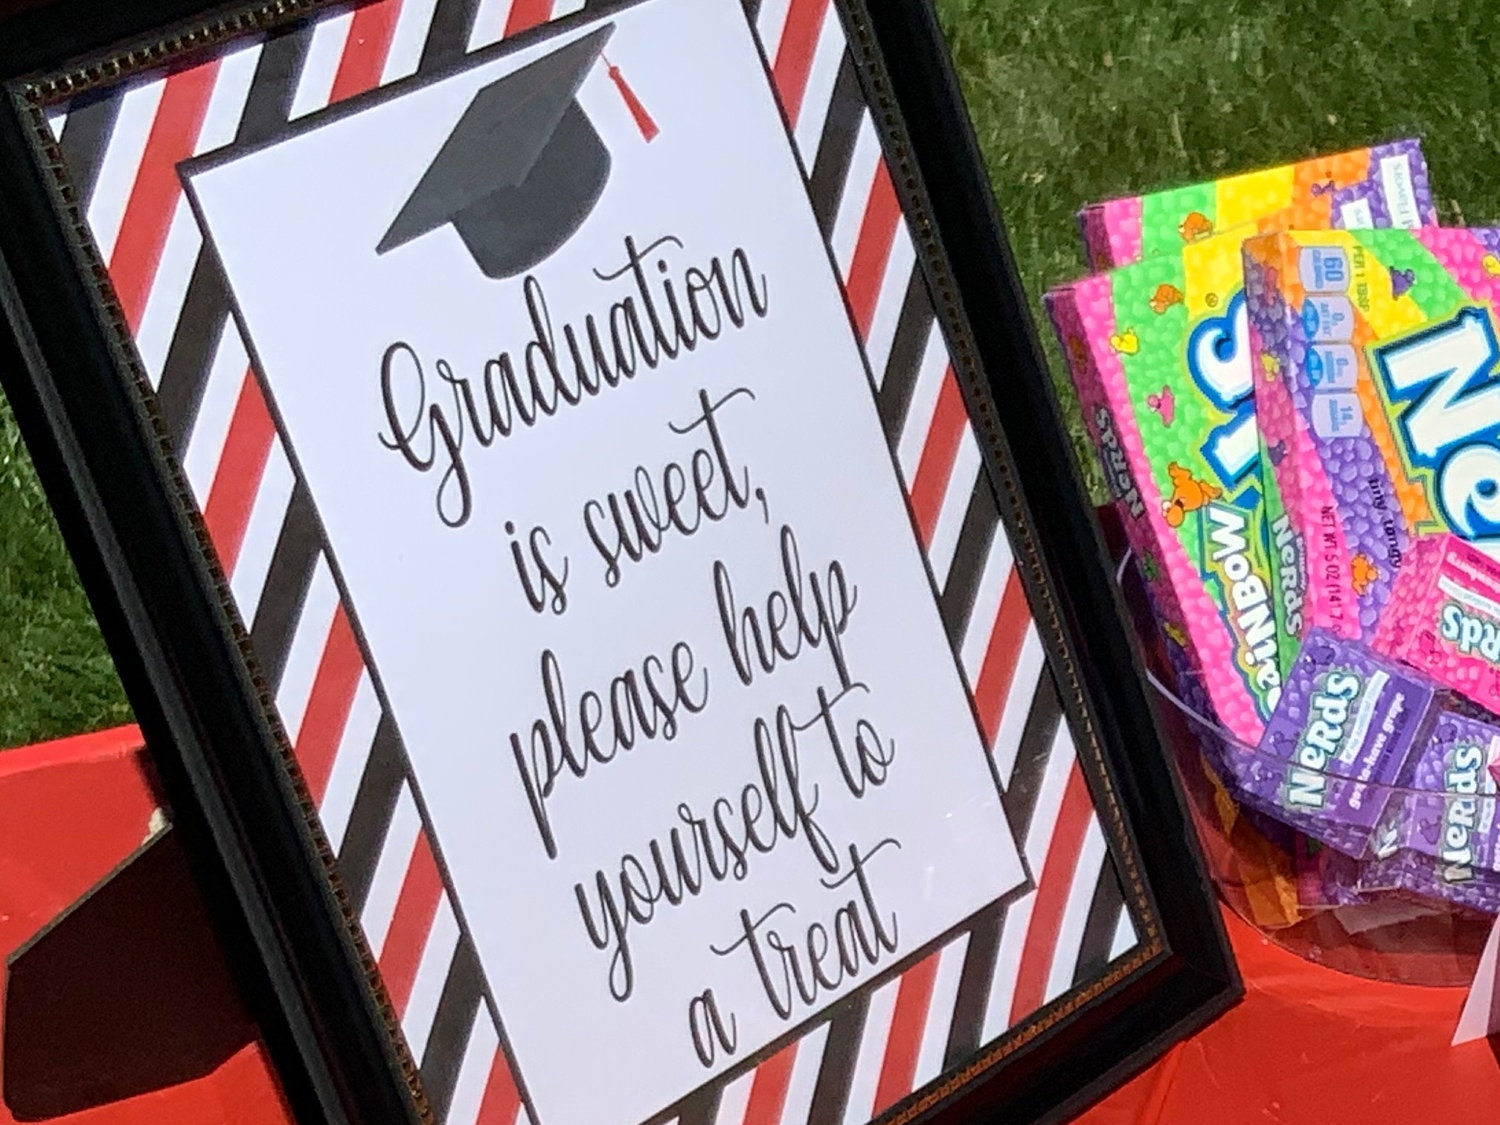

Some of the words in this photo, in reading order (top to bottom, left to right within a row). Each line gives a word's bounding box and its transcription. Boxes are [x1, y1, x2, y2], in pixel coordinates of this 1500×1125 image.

[1323, 256, 1344, 282] 60
[378, 236, 768, 527] Graduation
[504, 521, 569, 615] is
[584, 388, 770, 587] sweet,
[509, 648, 710, 861] please
[713, 524, 858, 690] help
[1382, 692, 1406, 735] grape
[573, 704, 842, 1002] yourself
[796, 682, 895, 799] to
[709, 837, 902, 1021] treat
[688, 988, 737, 1069] a
